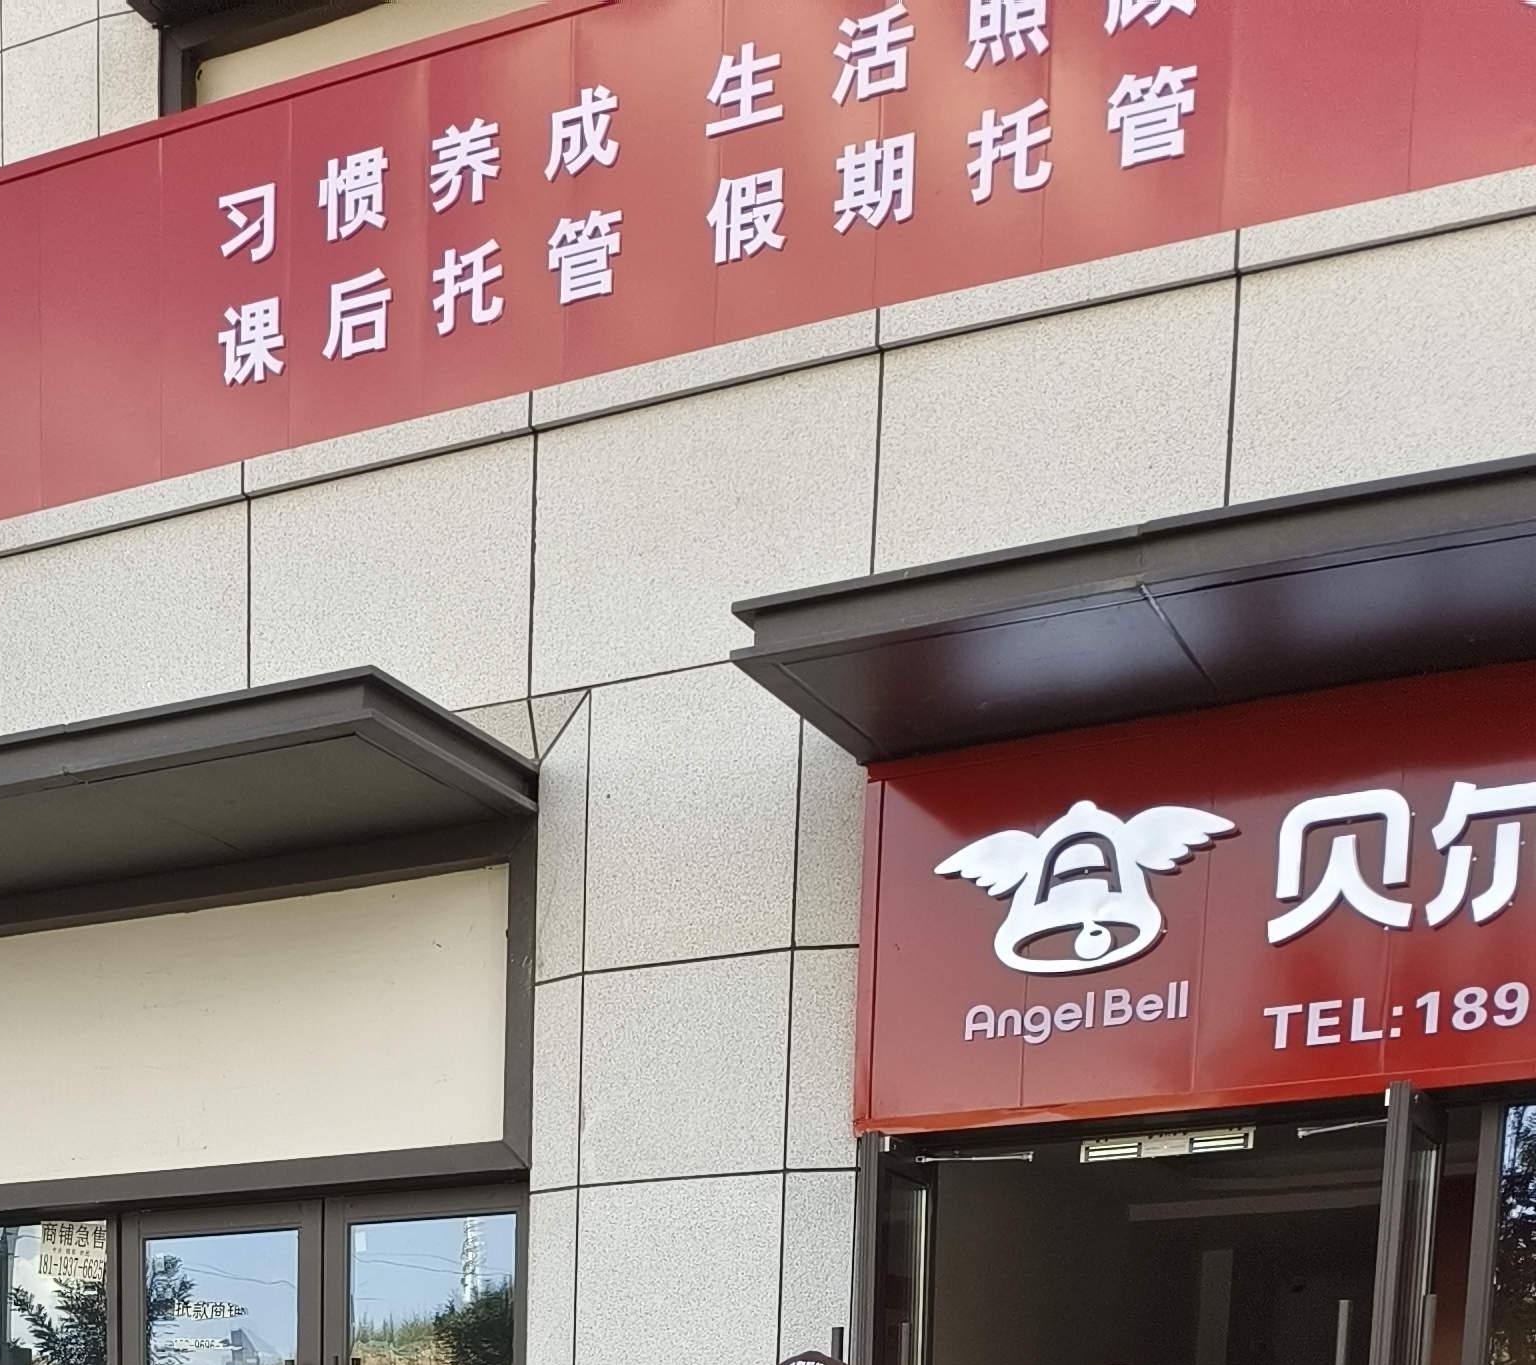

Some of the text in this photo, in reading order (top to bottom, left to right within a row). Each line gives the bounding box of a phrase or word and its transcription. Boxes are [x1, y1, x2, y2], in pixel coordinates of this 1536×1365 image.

[217, 84, 619, 263] 习惯养成
[218, 65, 1199, 386] 课后托管 假期托管
[1267, 780, 1536, 945] 贝尔
[41, 1223, 106, 1249] 商铺急售
